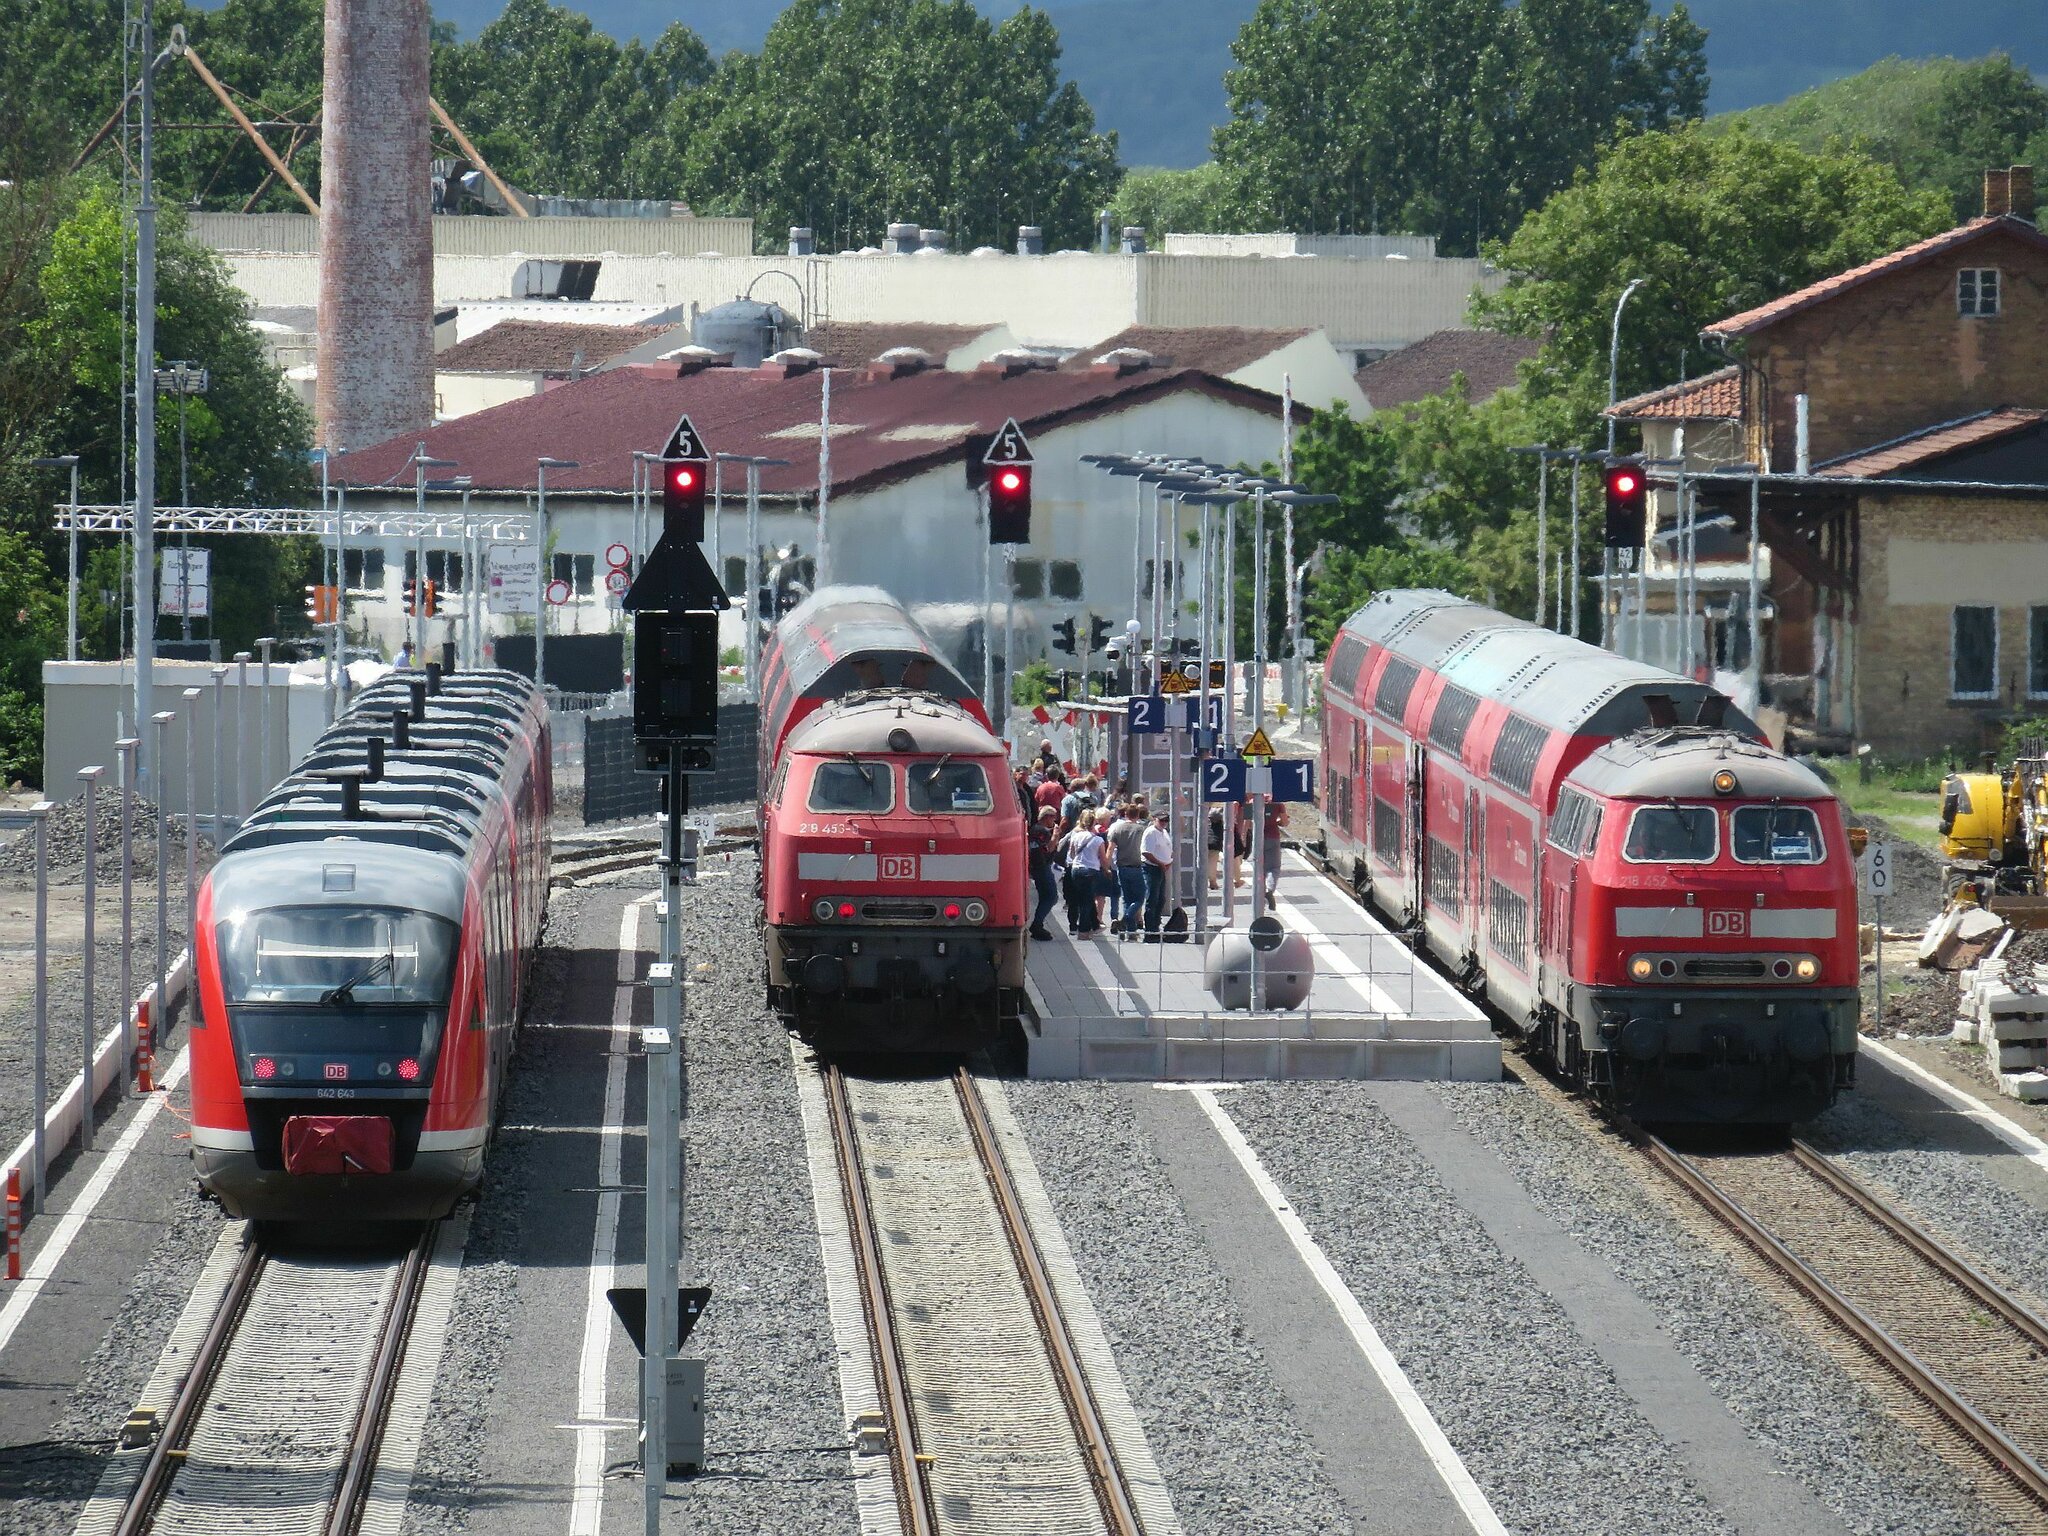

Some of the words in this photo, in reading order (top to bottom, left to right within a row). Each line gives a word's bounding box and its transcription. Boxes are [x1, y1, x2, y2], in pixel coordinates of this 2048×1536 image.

[679, 430, 692, 456] 5
[1004, 432, 1017, 459] 5
[1133, 700, 1150, 726] 2
[1208, 700, 1218, 727] 1
[1210, 763, 1230, 793] 2
[1295, 763, 1308, 793] 1
[884, 858, 913, 877] DB
[1620, 875, 1640, 887] 218
[1644, 875, 1668, 887] 452
[1711, 912, 1744, 933] DB
[327, 1065, 346, 1077] DB
[317, 1088, 335, 1099] 642
[337, 1088, 355, 1099] 643
